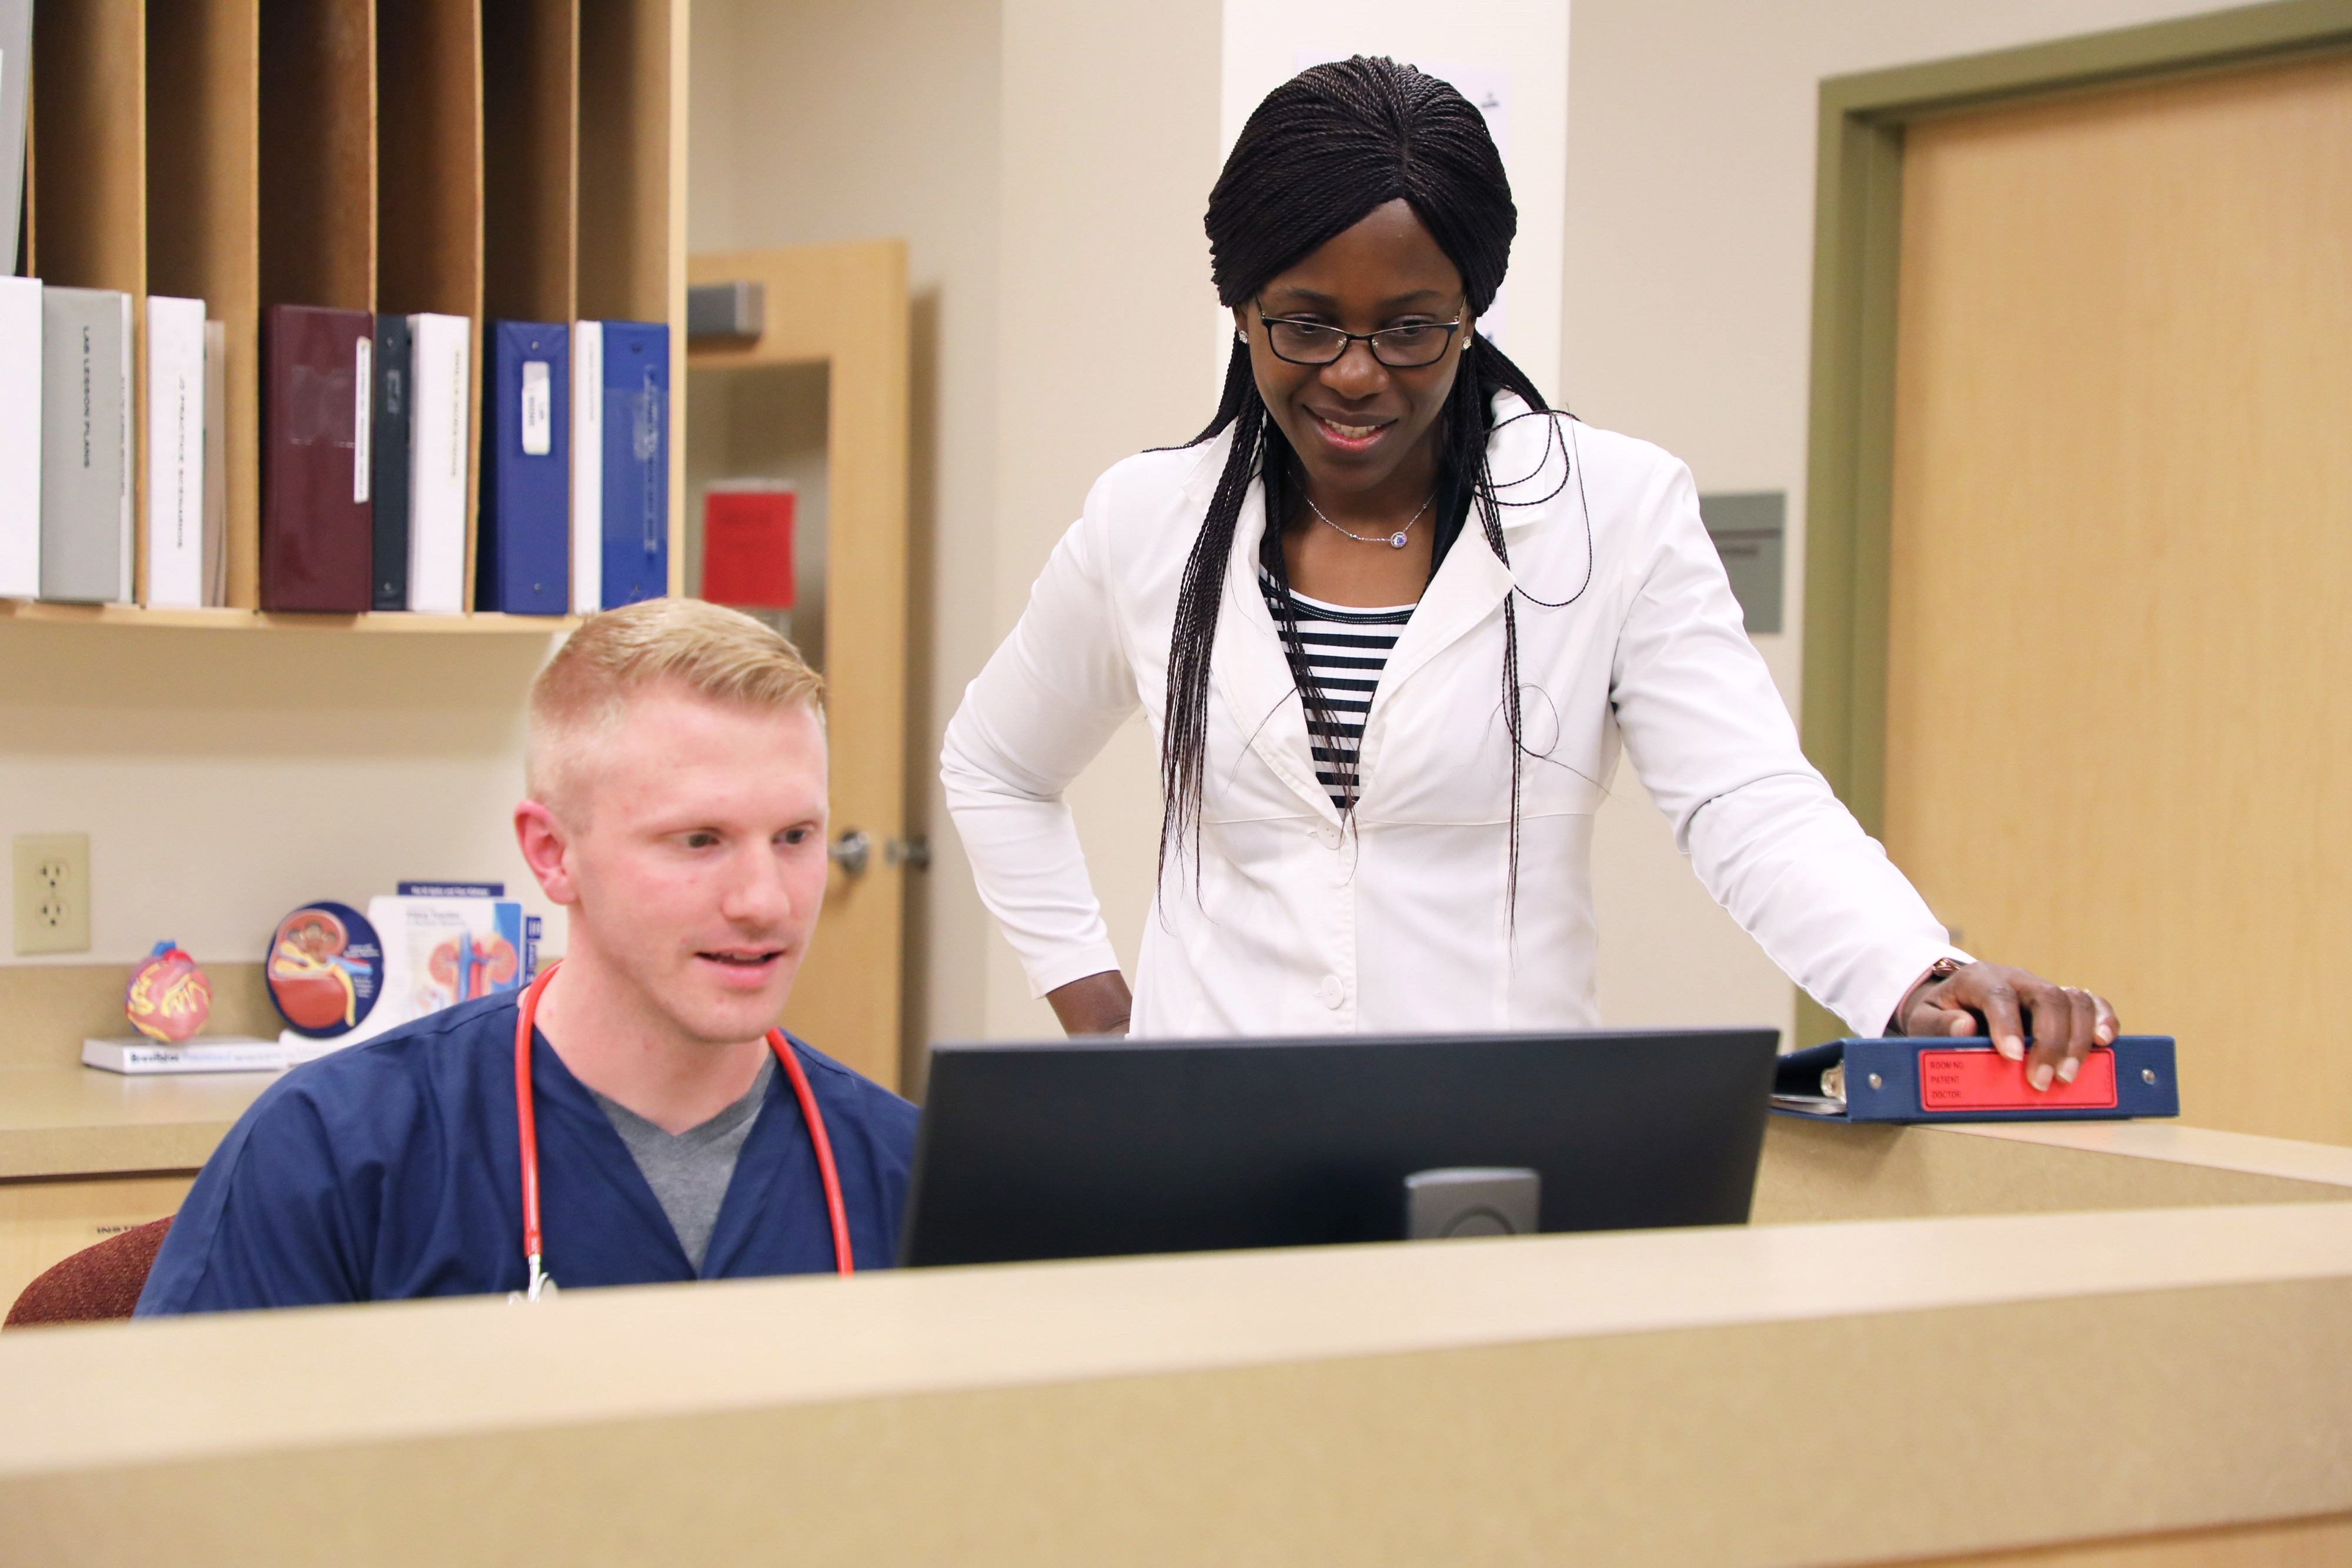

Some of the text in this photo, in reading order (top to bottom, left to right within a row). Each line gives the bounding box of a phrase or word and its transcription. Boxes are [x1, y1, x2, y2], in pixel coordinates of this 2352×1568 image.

[1930, 1061, 1952, 1069] ROOM
[1932, 1076, 1960, 1084] PATIENT
[1932, 1090, 1962, 1099] DOCTOR
